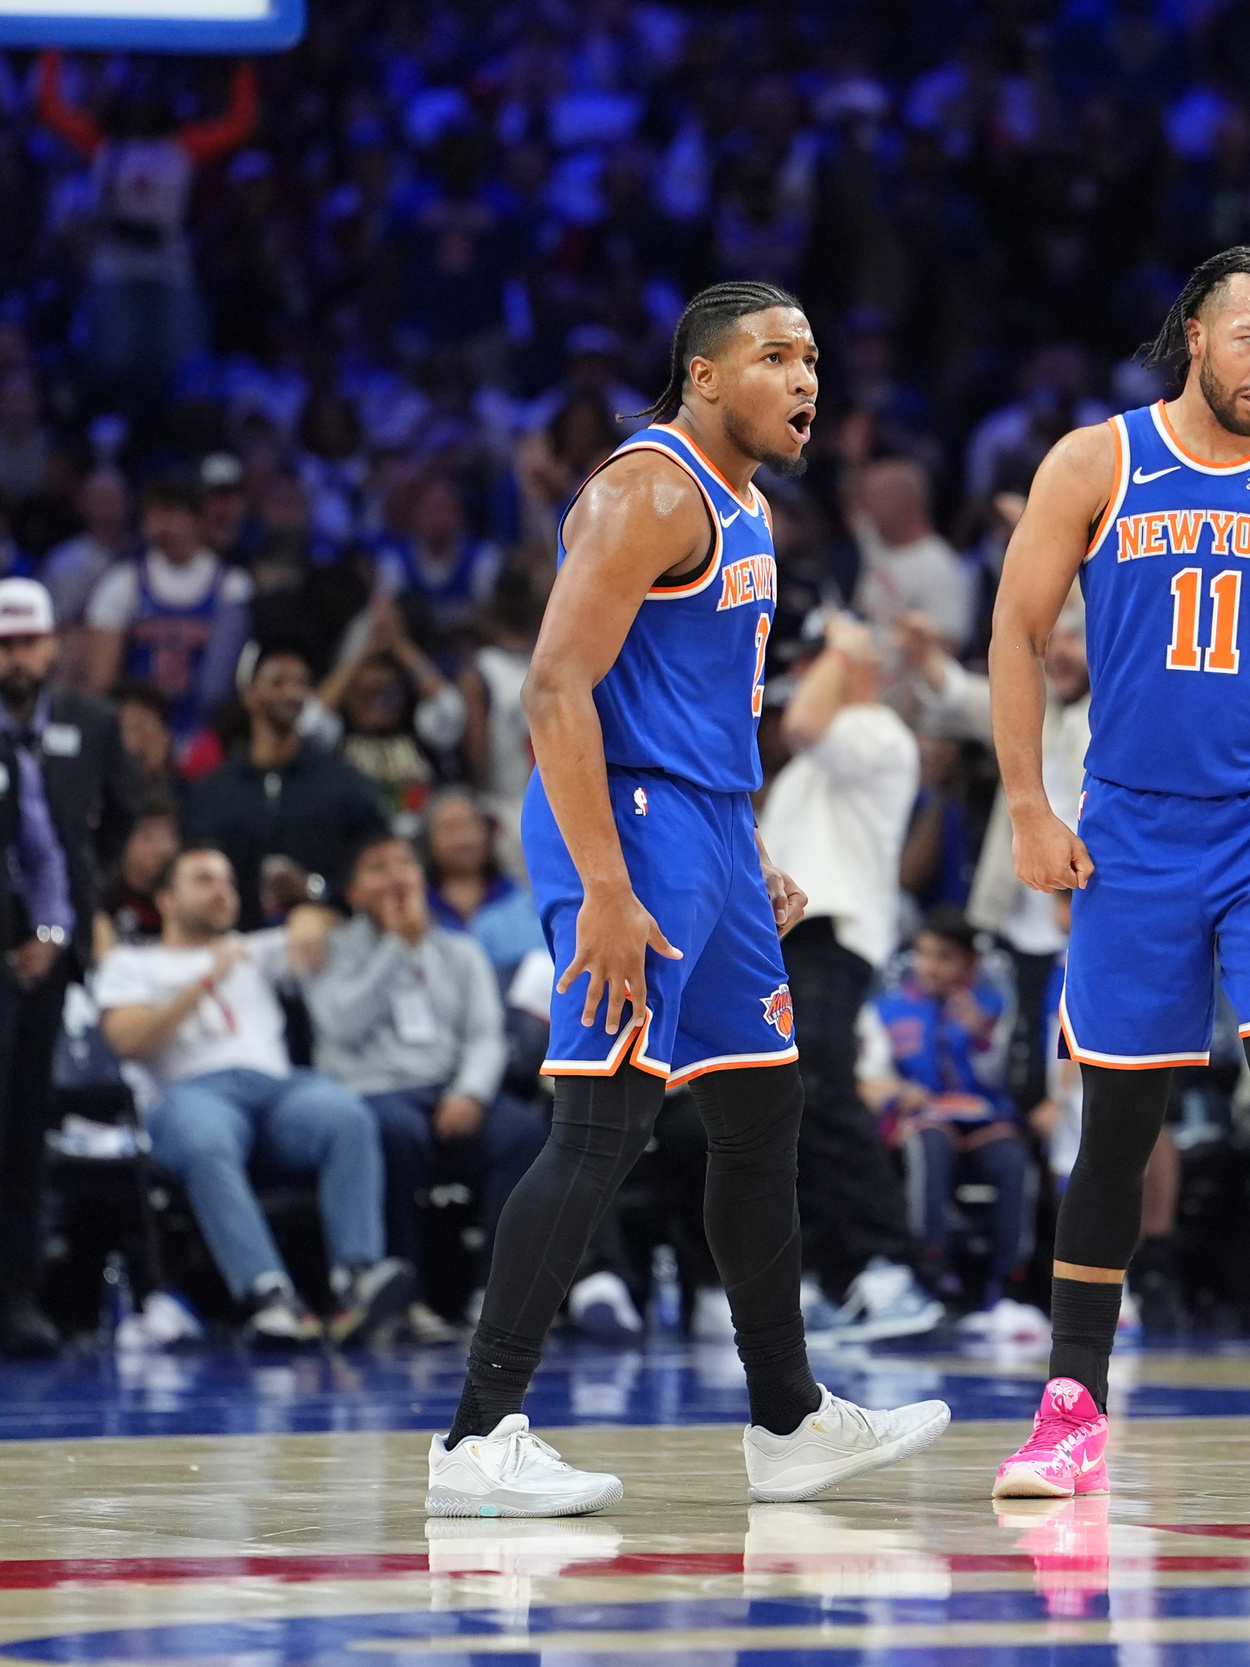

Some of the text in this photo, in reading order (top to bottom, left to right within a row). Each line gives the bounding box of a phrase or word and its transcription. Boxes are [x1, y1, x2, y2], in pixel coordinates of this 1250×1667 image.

[1116, 510, 1207, 563] NEW
[716, 554, 767, 612] NEW
[1166, 567, 1242, 675] 11
[751, 612, 771, 718] 2
